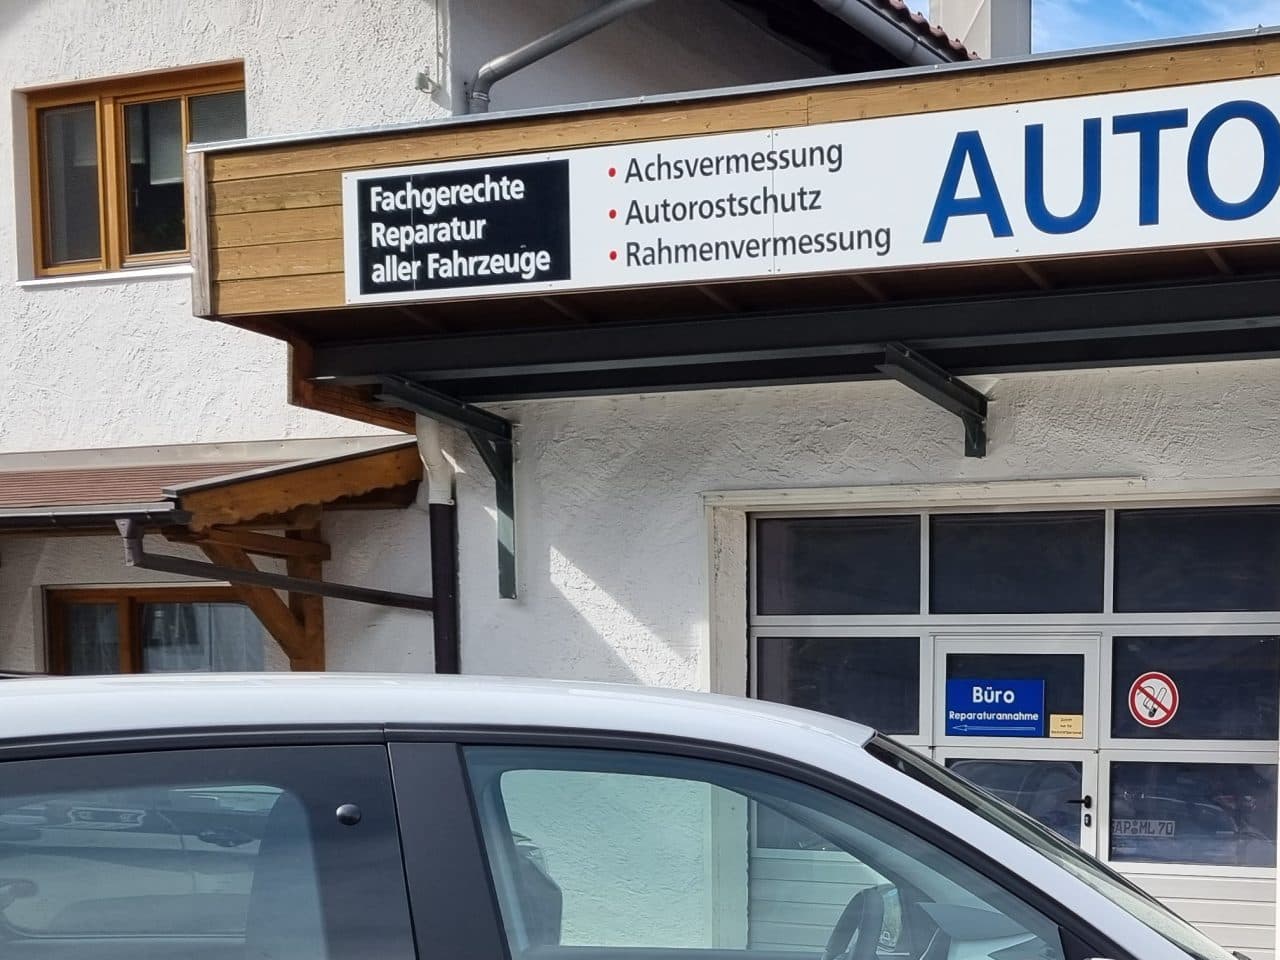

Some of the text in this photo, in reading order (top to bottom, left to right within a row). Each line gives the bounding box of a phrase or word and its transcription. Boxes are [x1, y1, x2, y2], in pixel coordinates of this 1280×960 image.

[625, 140, 844, 184] Achsvermessung
[369, 175, 525, 215] Fachgerechte
[625, 186, 823, 226] Autorostschutz
[370, 214, 487, 253] Reparatur
[625, 223, 892, 267] Rahmenvermessung
[371, 249, 551, 284] aller Fahrzeuge
[972, 686, 1015, 704] Büro
[948, 710, 1039, 722] Reparaturannahme
